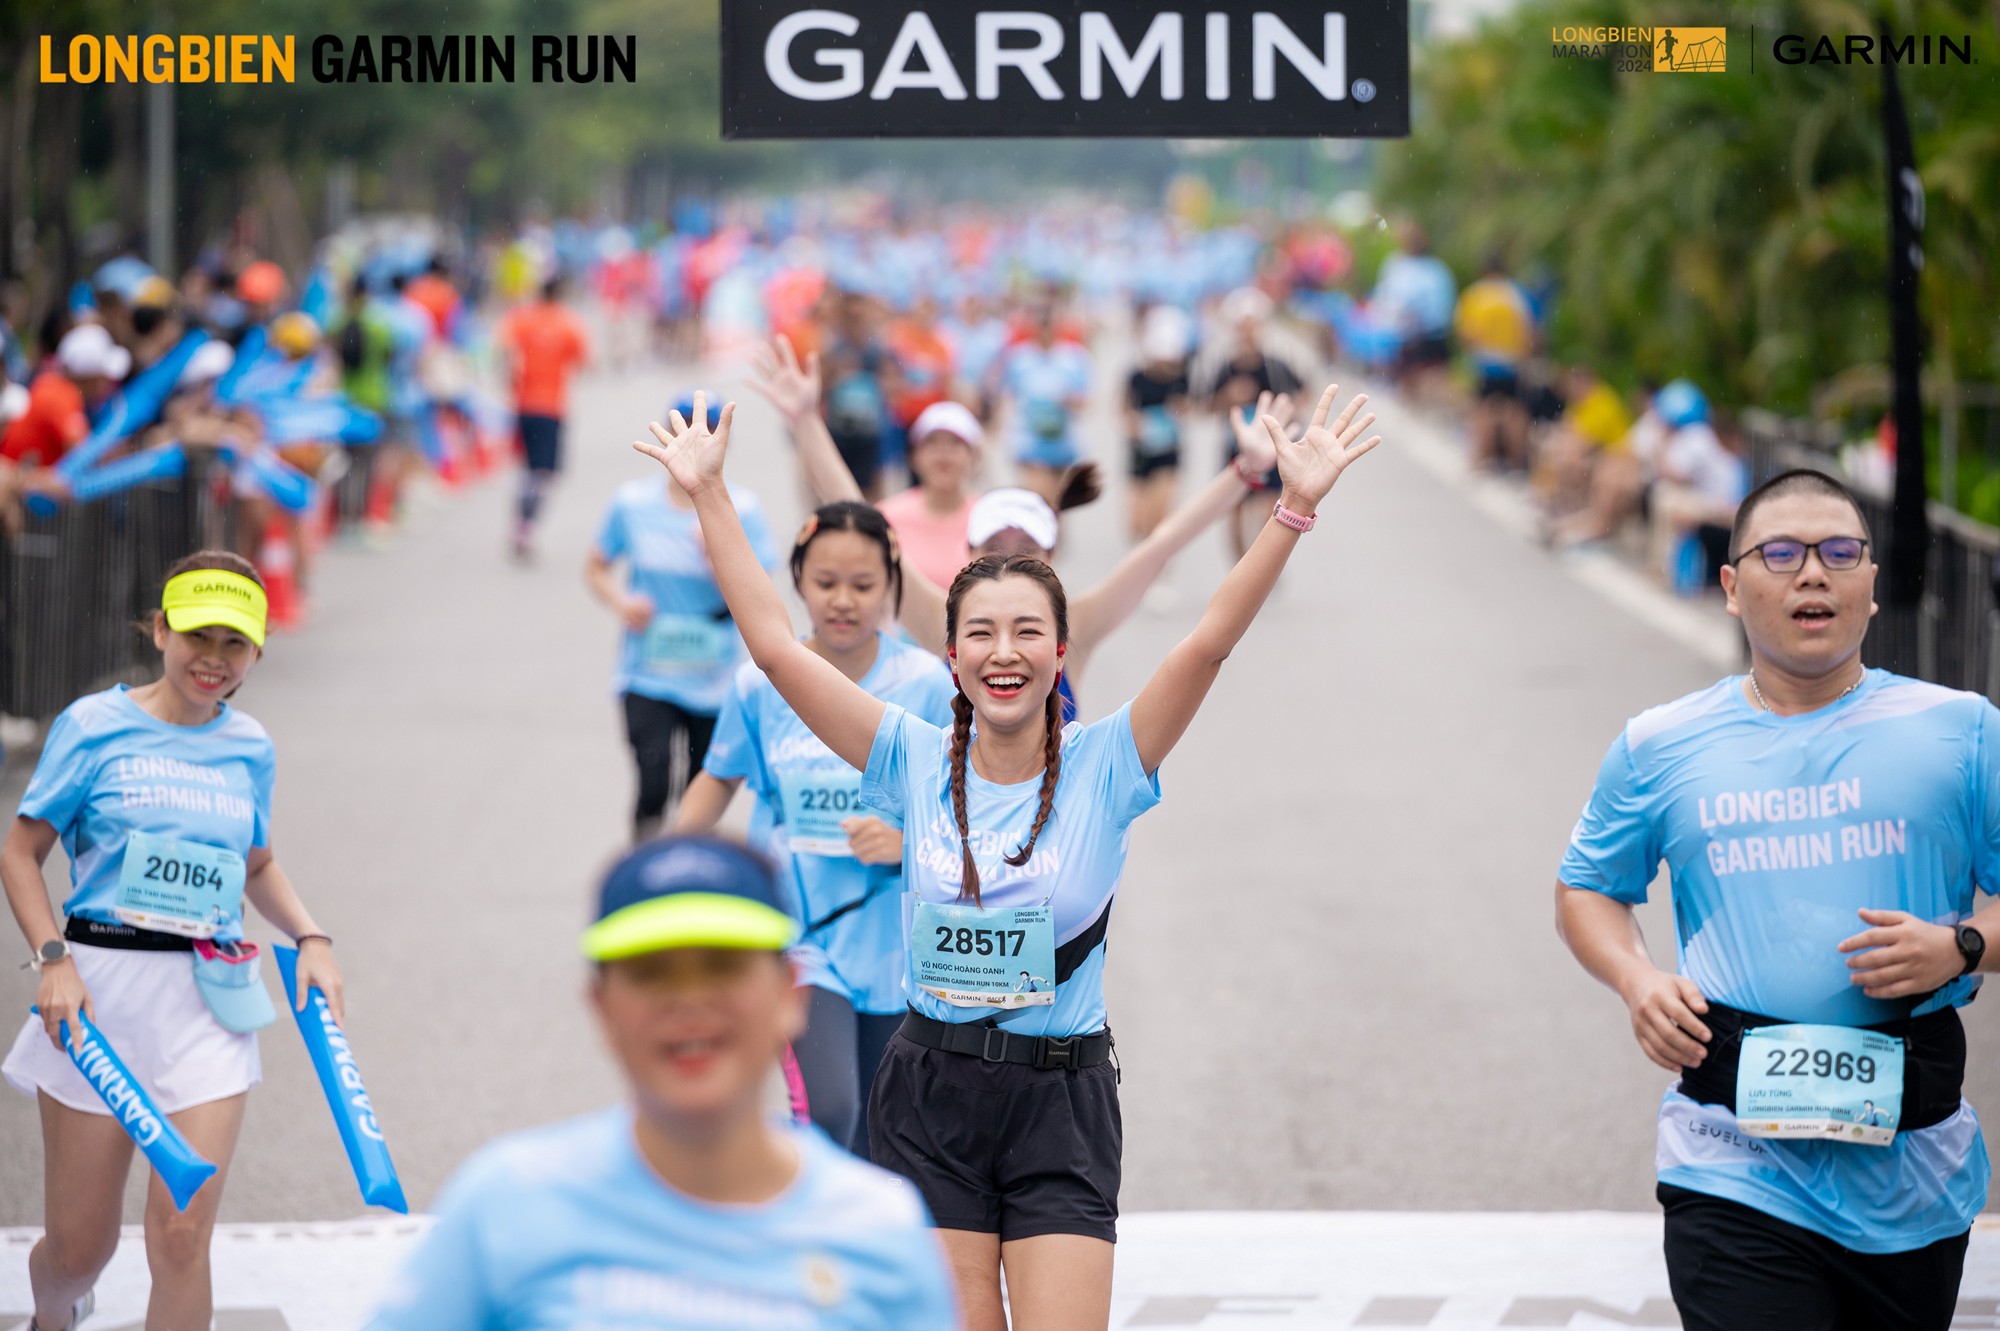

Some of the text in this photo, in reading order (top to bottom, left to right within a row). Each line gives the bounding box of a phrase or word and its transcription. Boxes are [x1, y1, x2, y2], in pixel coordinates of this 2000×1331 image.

[763, 9, 1347, 100] GARMIN
[193, 583, 252, 601] GARMIN
[119, 755, 226, 787] LONGBIEN
[122, 784, 252, 822] GARMIN RUN
[800, 788, 868, 811] 2202
[1697, 777, 1862, 829] LONGBIEN
[1706, 819, 1906, 877] GARMIN RUN
[144, 855, 223, 892] 20164
[935, 926, 1026, 957] 28517
[921, 960, 1005, 975] VŨ NGỌC HOÀNG OANH
[921, 974, 951, 984] LONGBIEN
[951, 993, 981, 1002] GARMIN
[1765, 1048, 1876, 1084] 22969
[1688, 1119, 1742, 1147] LEVEL
[1784, 1123, 1819, 1131] GARMIN
